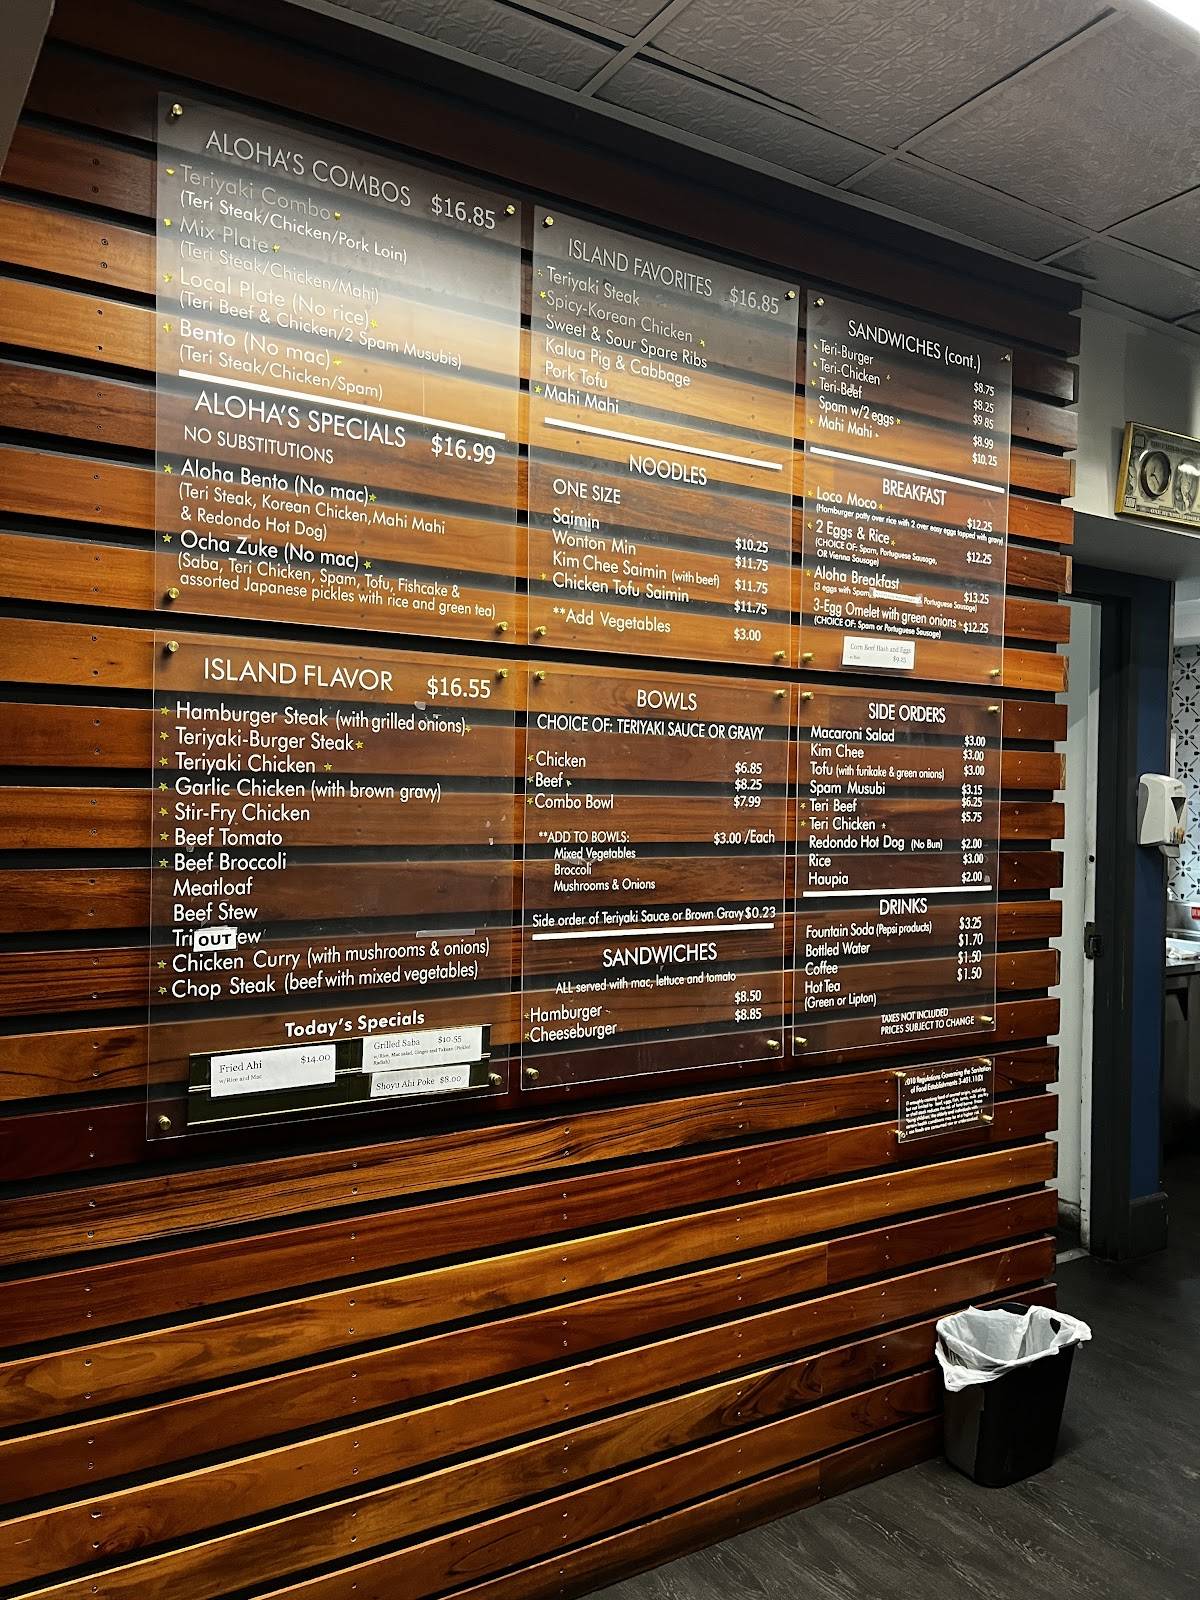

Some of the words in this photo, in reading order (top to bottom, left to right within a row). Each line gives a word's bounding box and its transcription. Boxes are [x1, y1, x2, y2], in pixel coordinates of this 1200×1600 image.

[180, 164, 254, 199] Teriyaki
[262, 186, 331, 220] Combo
[206, 130, 304, 177] ALOHA'S
[312, 159, 411, 208] COMBOS
[431, 194, 496, 229] $16.85
[180, 190, 213, 212] (Teri
[219, 199, 371, 254] Steak/Chicken/Pork
[374, 243, 408, 264] Loin)
[180, 216, 215, 240] Mix
[223, 227, 269, 253] Plate
[547, 266, 599, 295] Teriyaki
[604, 282, 640, 306] Steak
[569, 239, 628, 272] ISLAND
[634, 258, 713, 297] FAVORITES
[729, 286, 779, 315] $16.85
[180, 267, 231, 294] Local
[239, 281, 286, 308] Plate
[292, 292, 326, 319] (No
[332, 305, 370, 330] rice)
[547, 290, 636, 328] Spicy-Korean
[641, 317, 693, 343] Chicken
[180, 319, 236, 347] Bento
[243, 332, 279, 359] (No
[286, 344, 331, 370] mac)
[848, 319, 941, 359] SANDWICHES
[945, 345, 981, 374] (cont.)
[820, 339, 874, 365] Teri-Burger
[974, 381, 995, 396] $8.75
[544, 384, 580, 407] Mahi
[585, 393, 620, 414] Mahi
[820, 358, 880, 385] Teri-Chicken
[973, 399, 994, 413] $8.25
[194, 390, 299, 429] ALOHA'S
[308, 411, 406, 448] SPECIALS
[431, 432, 496, 465] $16.99
[184, 424, 212, 444] NO
[217, 431, 334, 464] SUBSTITUTIONS
[181, 458, 234, 484] Aloha
[241, 468, 288, 491] Bento
[294, 475, 324, 498] (No
[330, 482, 369, 506] mac)
[629, 454, 708, 486] NOODLES
[553, 478, 588, 498] ONE
[592, 485, 621, 504] SIZE
[883, 478, 947, 506] BREAKFAST
[817, 486, 842, 504] Loco
[847, 492, 877, 509] Moco
[967, 517, 993, 532] $12.25
[553, 507, 600, 529] Saimin
[735, 538, 769, 553] $10.25
[816, 520, 823, 533] 2
[826, 522, 852, 540] Eggs
[856, 527, 866, 540] &
[869, 528, 890, 544] Rice
[966, 551, 992, 565] $12.25
[181, 529, 230, 552] Ocha
[236, 536, 278, 559] Zuke
[284, 542, 314, 564] (No
[321, 549, 359, 571] mac)
[552, 529, 606, 551] Wonton
[611, 538, 636, 555] Min
[735, 556, 769, 571] $11.75
[814, 566, 847, 583] Aloha
[852, 571, 900, 590] Breakfast
[964, 592, 989, 604] $13.25
[600, 611, 671, 633] Vegetables
[734, 628, 761, 641] $3.00
[204, 658, 296, 684] ISLAND
[304, 665, 394, 692] FLAVOR
[426, 676, 491, 699] $16.55
[637, 689, 698, 711] BOWLS
[869, 703, 895, 720] SIDE
[900, 705, 946, 723] ORDERS
[176, 701, 278, 727] Hamburger
[284, 706, 329, 727] Steak
[335, 709, 369, 729] (with
[371, 711, 415, 732] grilled
[418, 715, 466, 736] onions)
[175, 726, 305, 752] Teriyaki-Burger
[310, 733, 354, 751] Steak
[811, 725, 862, 740] Macaroni
[866, 728, 895, 742] Salad
[964, 736, 986, 747] $3.00
[175, 752, 242, 776] Teriyaki
[248, 754, 316, 774] Chicken
[536, 751, 586, 768] Chicken
[735, 762, 762, 775] $6.85
[535, 772, 563, 787] Beef
[734, 779, 762, 791] $8.25
[810, 780, 841, 795] Spam
[847, 781, 885, 795] Musubi
[962, 784, 982, 796] $3.15
[174, 803, 238, 825] Stir-Fry
[242, 803, 311, 822] Chicken
[534, 793, 582, 809] Combo
[586, 794, 614, 809] Bowl
[733, 796, 761, 809] $7.99
[174, 828, 214, 846] Beef
[219, 828, 283, 846] Tomato
[575, 832, 587, 843] TO
[592, 831, 629, 843] BOWLS:
[713, 831, 741, 844] $3.00
[744, 829, 775, 844] /Each
[174, 853, 214, 872] Beef
[219, 852, 287, 871] Broccoli
[554, 862, 592, 876] Broccoli
[173, 876, 253, 897] Meatloaf
[808, 872, 849, 887] Haupia
[961, 872, 982, 883] $2.00
[173, 902, 212, 922] Beef
[218, 902, 258, 921] Stew
[880, 898, 928, 916] DRINKS
[199, 934, 231, 946] OUT
[806, 944, 839, 958] Bottled
[842, 942, 871, 954] Water
[958, 933, 983, 946] $1.70
[602, 942, 718, 967] SANDWICHES
[805, 961, 838, 976] Coffee
[958, 951, 981, 964] $1.50
[805, 981, 823, 994] Hot
[824, 979, 841, 992] Tea
[957, 967, 982, 982] $1.50
[530, 1004, 602, 1024] Hamburger
[734, 990, 761, 1004] $8.50
[881, 1014, 900, 1023] TAXES
[901, 1012, 916, 1021] NOT
[917, 1008, 948, 1019] INCLUDED
[285, 1018, 353, 1038] Today's
[358, 1009, 425, 1032] Specials
[530, 1023, 617, 1043] Cheeseburger
[734, 1008, 761, 1021] $8.85
[374, 1040, 400, 1049] Grilled
[402, 1039, 420, 1047] Saba
[219, 1062, 243, 1073] Fried
[246, 1060, 262, 1070] Ahi
[300, 1054, 330, 1064] $14.00
[376, 1081, 399, 1090] Shoyu
[417, 1078, 434, 1086] Poke
